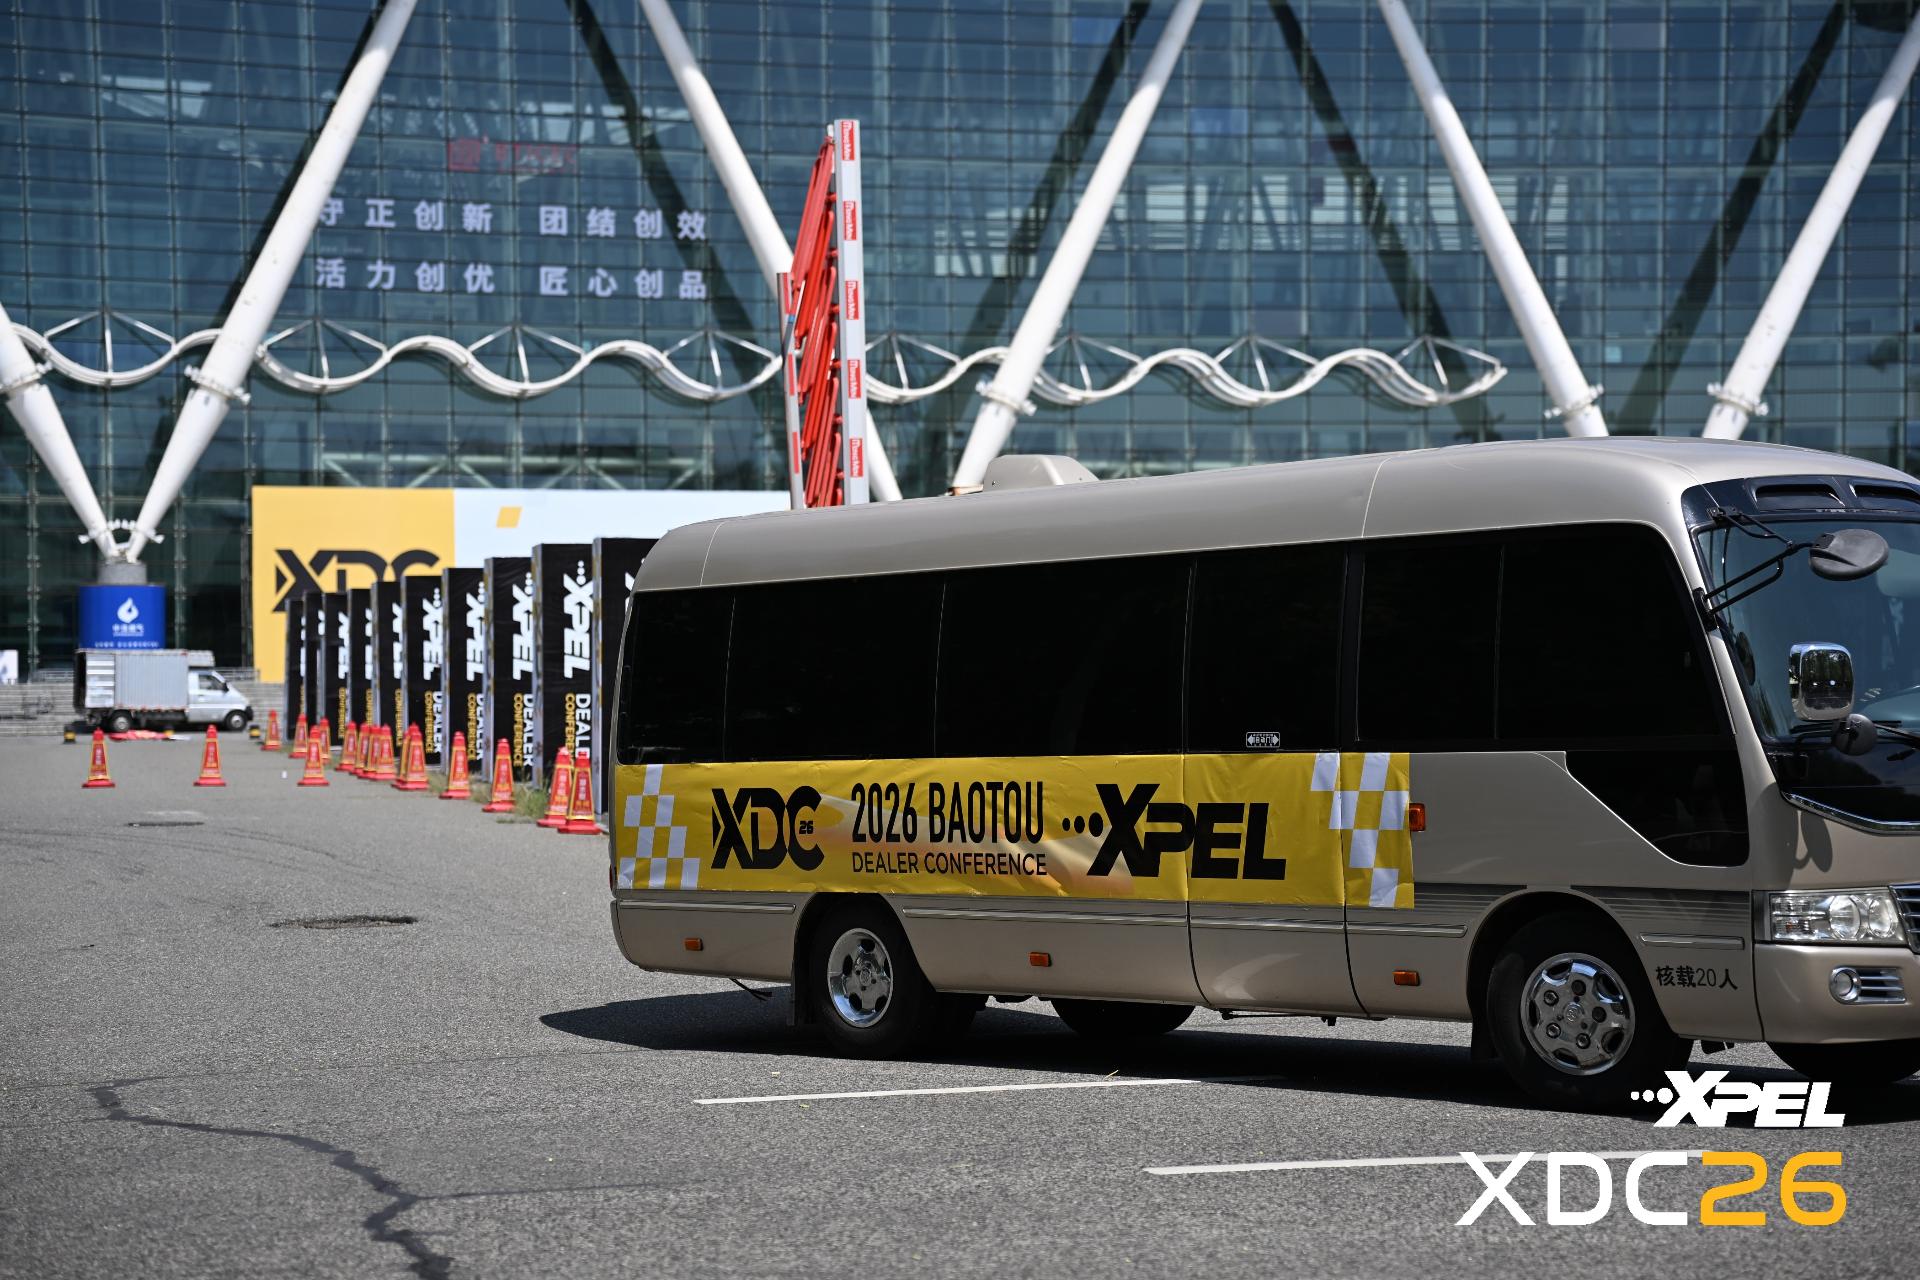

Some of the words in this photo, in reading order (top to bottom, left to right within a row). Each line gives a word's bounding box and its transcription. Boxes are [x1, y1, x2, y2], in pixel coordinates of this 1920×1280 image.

[319, 198, 493, 233] 守正创新
[539, 205, 706, 240] 团结创效
[316, 258, 495, 293] 活力创优
[539, 266, 706, 299] 匠心创品
[513, 584, 533, 680] XPEL
[563, 573, 593, 679] XPEL
[514, 693, 523, 767] CONFERENCE
[523, 694, 533, 767] DEALER
[575, 694, 591, 759] DEALE
[711, 785, 825, 871] XDC
[799, 820, 814, 835] 26
[851, 782, 918, 844] 2026
[928, 781, 1044, 844] BAOTOU
[1086, 783, 1287, 880] XPEL
[852, 852, 919, 874] DEALER
[924, 852, 1048, 876] CONFERENCE
[1655, 965, 1738, 990] 核载20人
